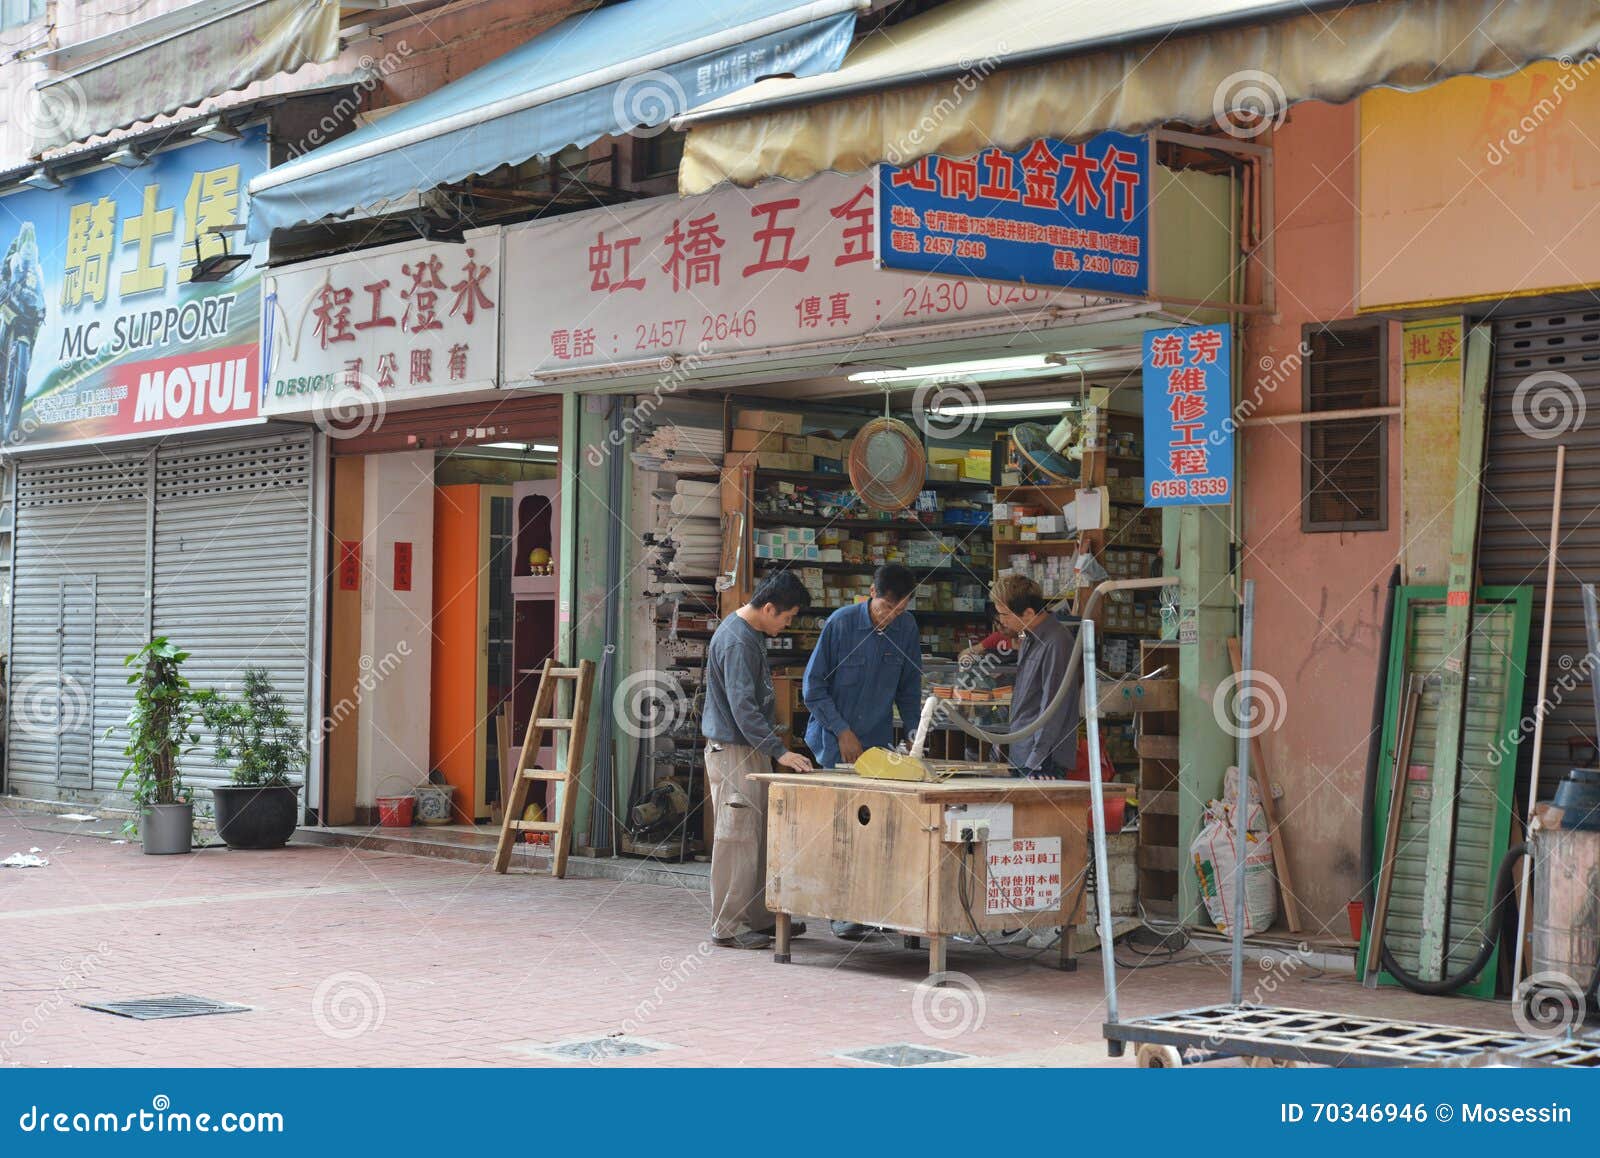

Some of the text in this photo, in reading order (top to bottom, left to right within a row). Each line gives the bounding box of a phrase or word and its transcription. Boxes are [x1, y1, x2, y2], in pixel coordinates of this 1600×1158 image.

[60, 164, 241, 306] 騎士堡
[588, 184, 874, 294] 虹橋五金
[924, 236, 953, 255] 2457
[956, 239, 986, 259] 2646
[1082, 255, 1111, 275] 2430
[1112, 259, 1140, 278] 0287
[59, 296, 236, 361] MC SUPPORT
[635, 319, 687, 350] 2457
[701, 310, 757, 341] 2646
[904, 281, 968, 316] 2430
[1410, 329, 1458, 360] 批發
[134, 357, 252, 424] MOTUL
[275, 372, 335, 397] DESIGN
[1167, 367, 1208, 475] 維修工程
[1151, 477, 1228, 497] 6158 3539
[990, 853, 1060, 866] 非本公司員工
